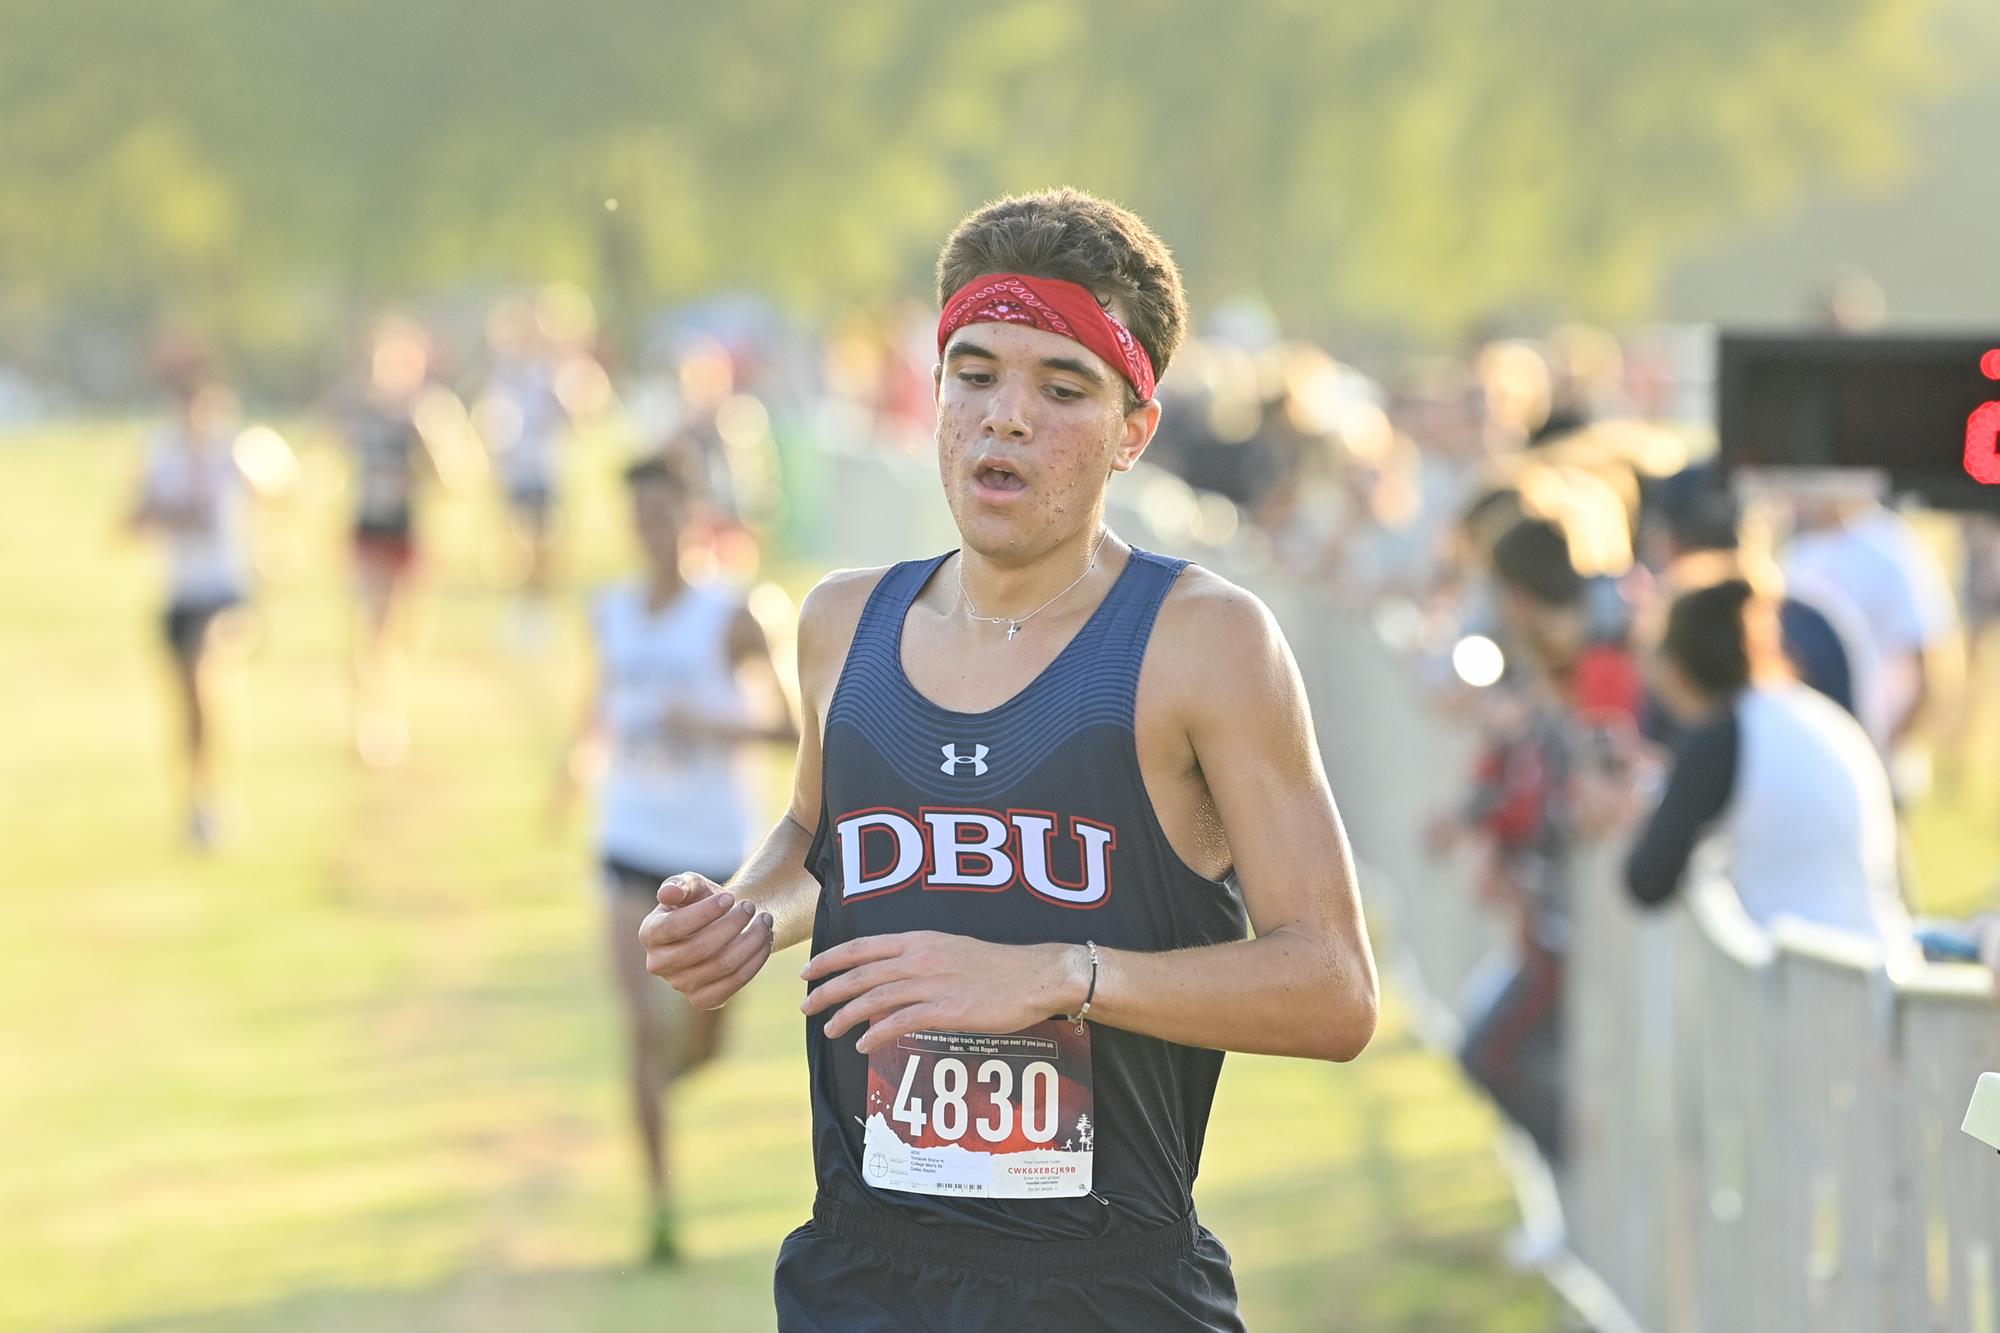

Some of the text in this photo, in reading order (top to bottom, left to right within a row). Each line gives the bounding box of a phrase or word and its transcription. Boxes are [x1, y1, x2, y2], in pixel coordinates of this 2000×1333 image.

[836, 807, 1116, 909] DBU
[947, 1036, 959, 1044] right
[960, 1037, 975, 1045] track,
[981, 1046, 999, 1054] Rogers
[892, 1054, 1059, 1144] 4830
